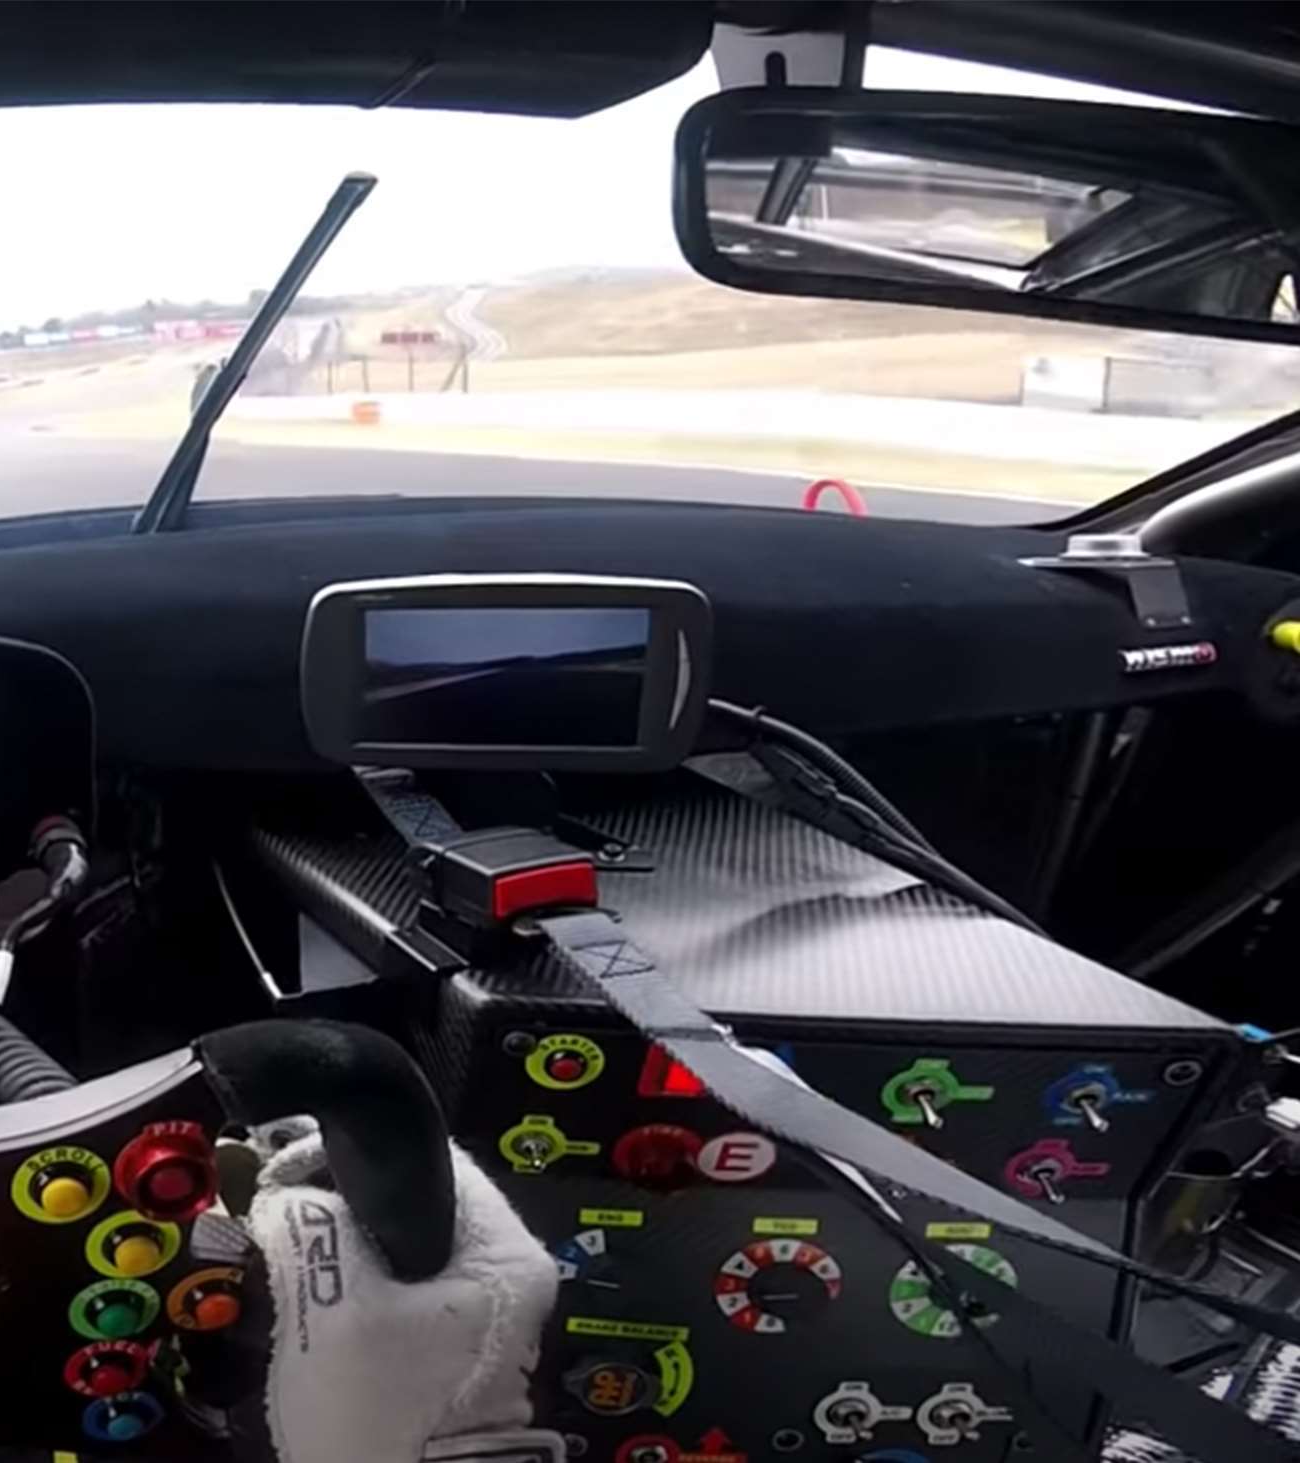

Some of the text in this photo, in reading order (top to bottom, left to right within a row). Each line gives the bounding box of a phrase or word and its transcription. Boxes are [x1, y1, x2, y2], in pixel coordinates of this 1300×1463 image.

[540, 1038, 599, 1061] STARTER
[153, 1121, 192, 1136] PIT
[26, 1148, 105, 1172] SCROLL
[714, 1141, 760, 1171] E
